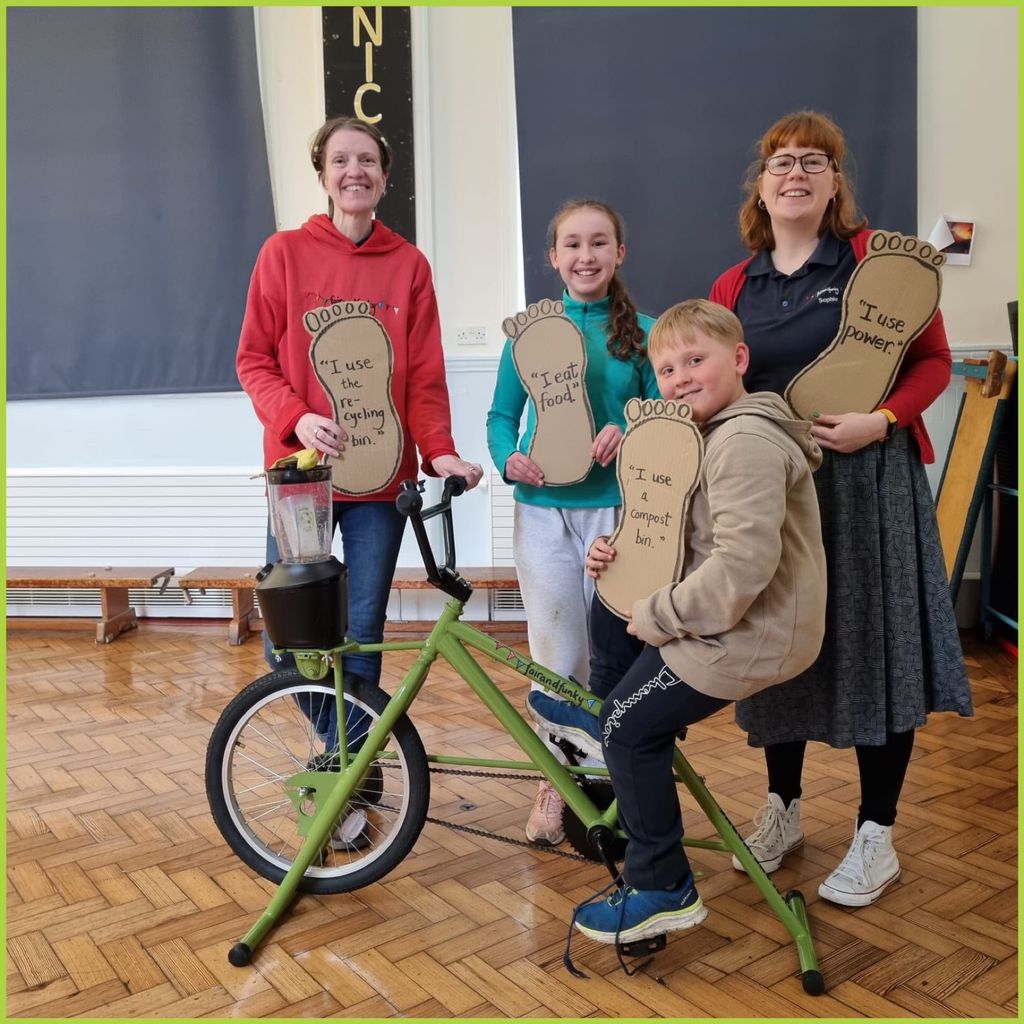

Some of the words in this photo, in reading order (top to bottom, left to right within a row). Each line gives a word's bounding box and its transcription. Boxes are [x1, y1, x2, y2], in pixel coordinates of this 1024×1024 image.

[859, 299, 878, 322] "I
[877, 313, 906, 333] use
[840, 325, 904, 356] power."
[320, 359, 342, 374] "I
[345, 358, 374, 371] use
[531, 371, 552, 389] "I
[554, 362, 578, 384] eat
[341, 377, 363, 389] the
[340, 398, 360, 408] re-
[538, 381, 579, 412] food."
[344, 407, 385, 431] cycling
[352, 430, 384, 447] bin."
[629, 465, 647, 481] "I
[652, 473, 672, 486] use
[641, 492, 648, 502] a
[630, 509, 672, 528] compost
[635, 528, 665, 549] bin."
[524, 661, 585, 707] fairandfunky
